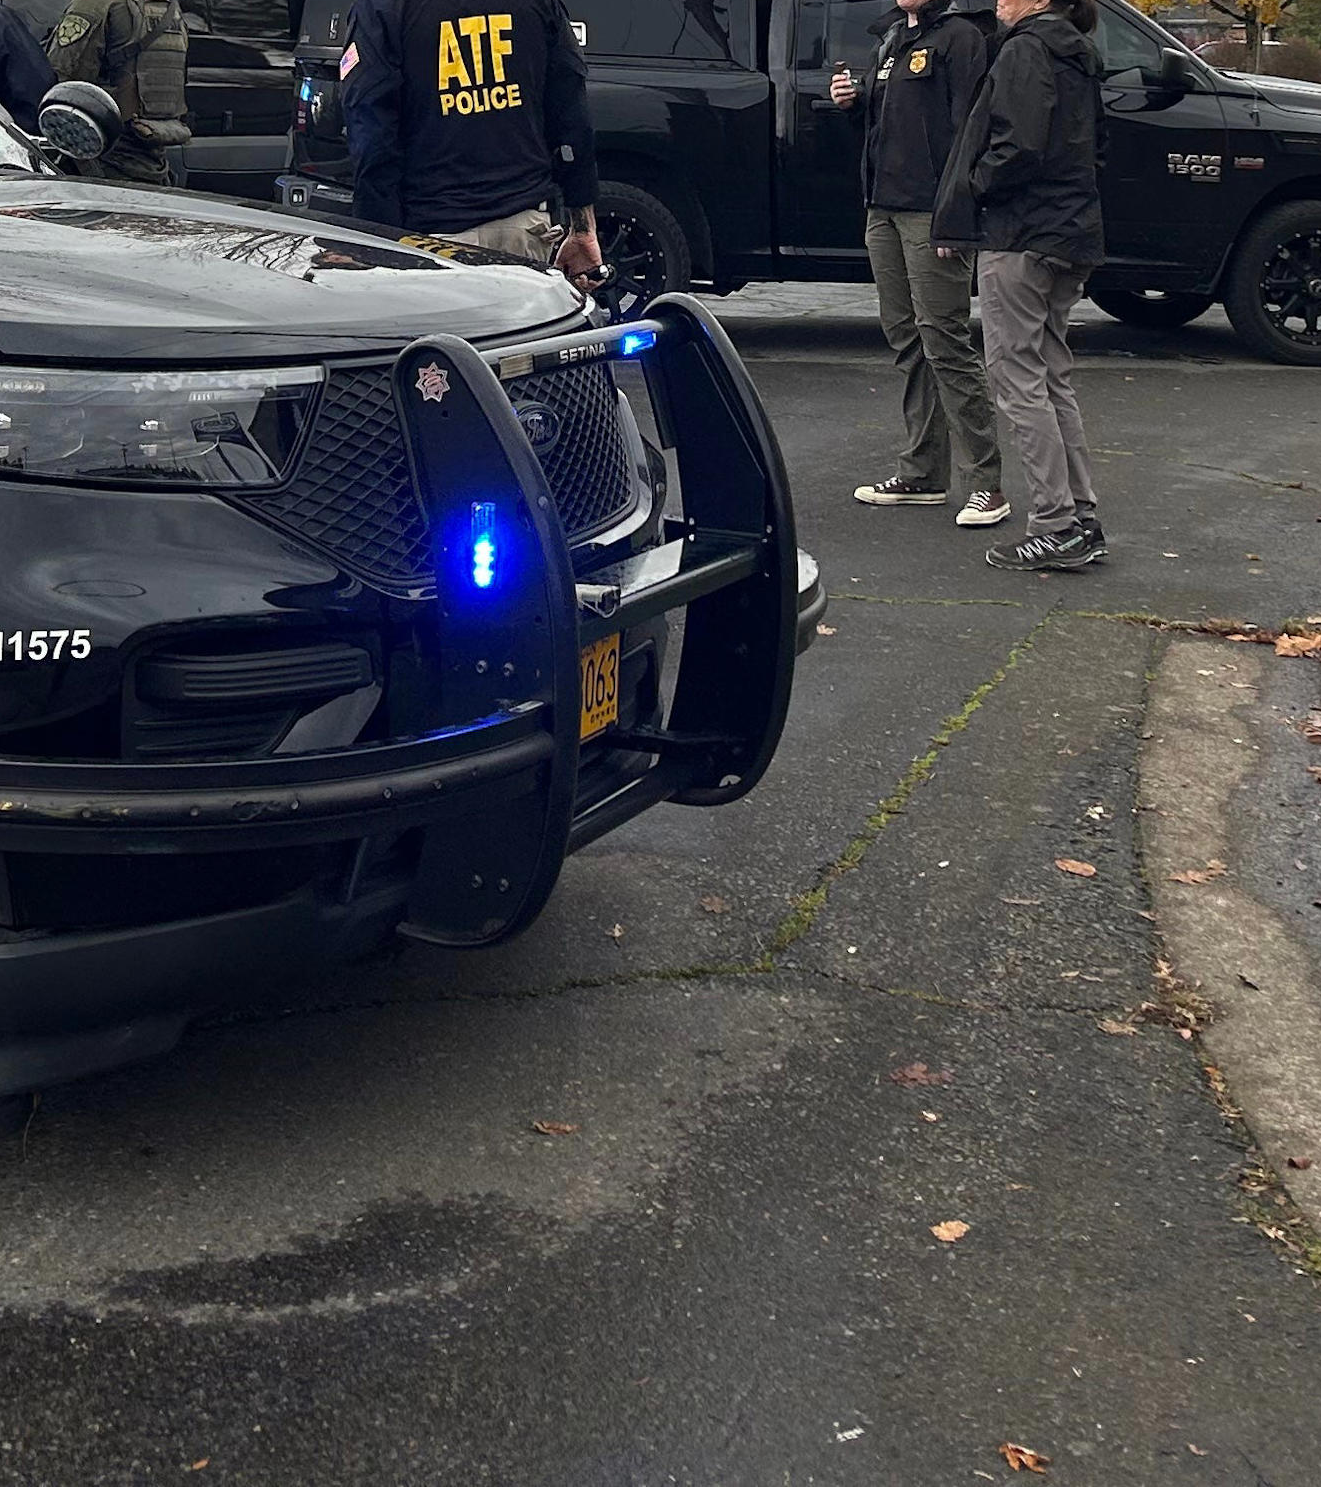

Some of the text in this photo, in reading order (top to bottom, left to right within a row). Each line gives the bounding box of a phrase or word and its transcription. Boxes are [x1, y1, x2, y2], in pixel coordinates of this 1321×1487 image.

[438, 14, 513, 91] ATF
[440, 83, 522, 116] POLICE
[1167, 164, 1221, 176] 1500
[559, 342, 607, 364] SETINA
[580, 648, 617, 713] 063
